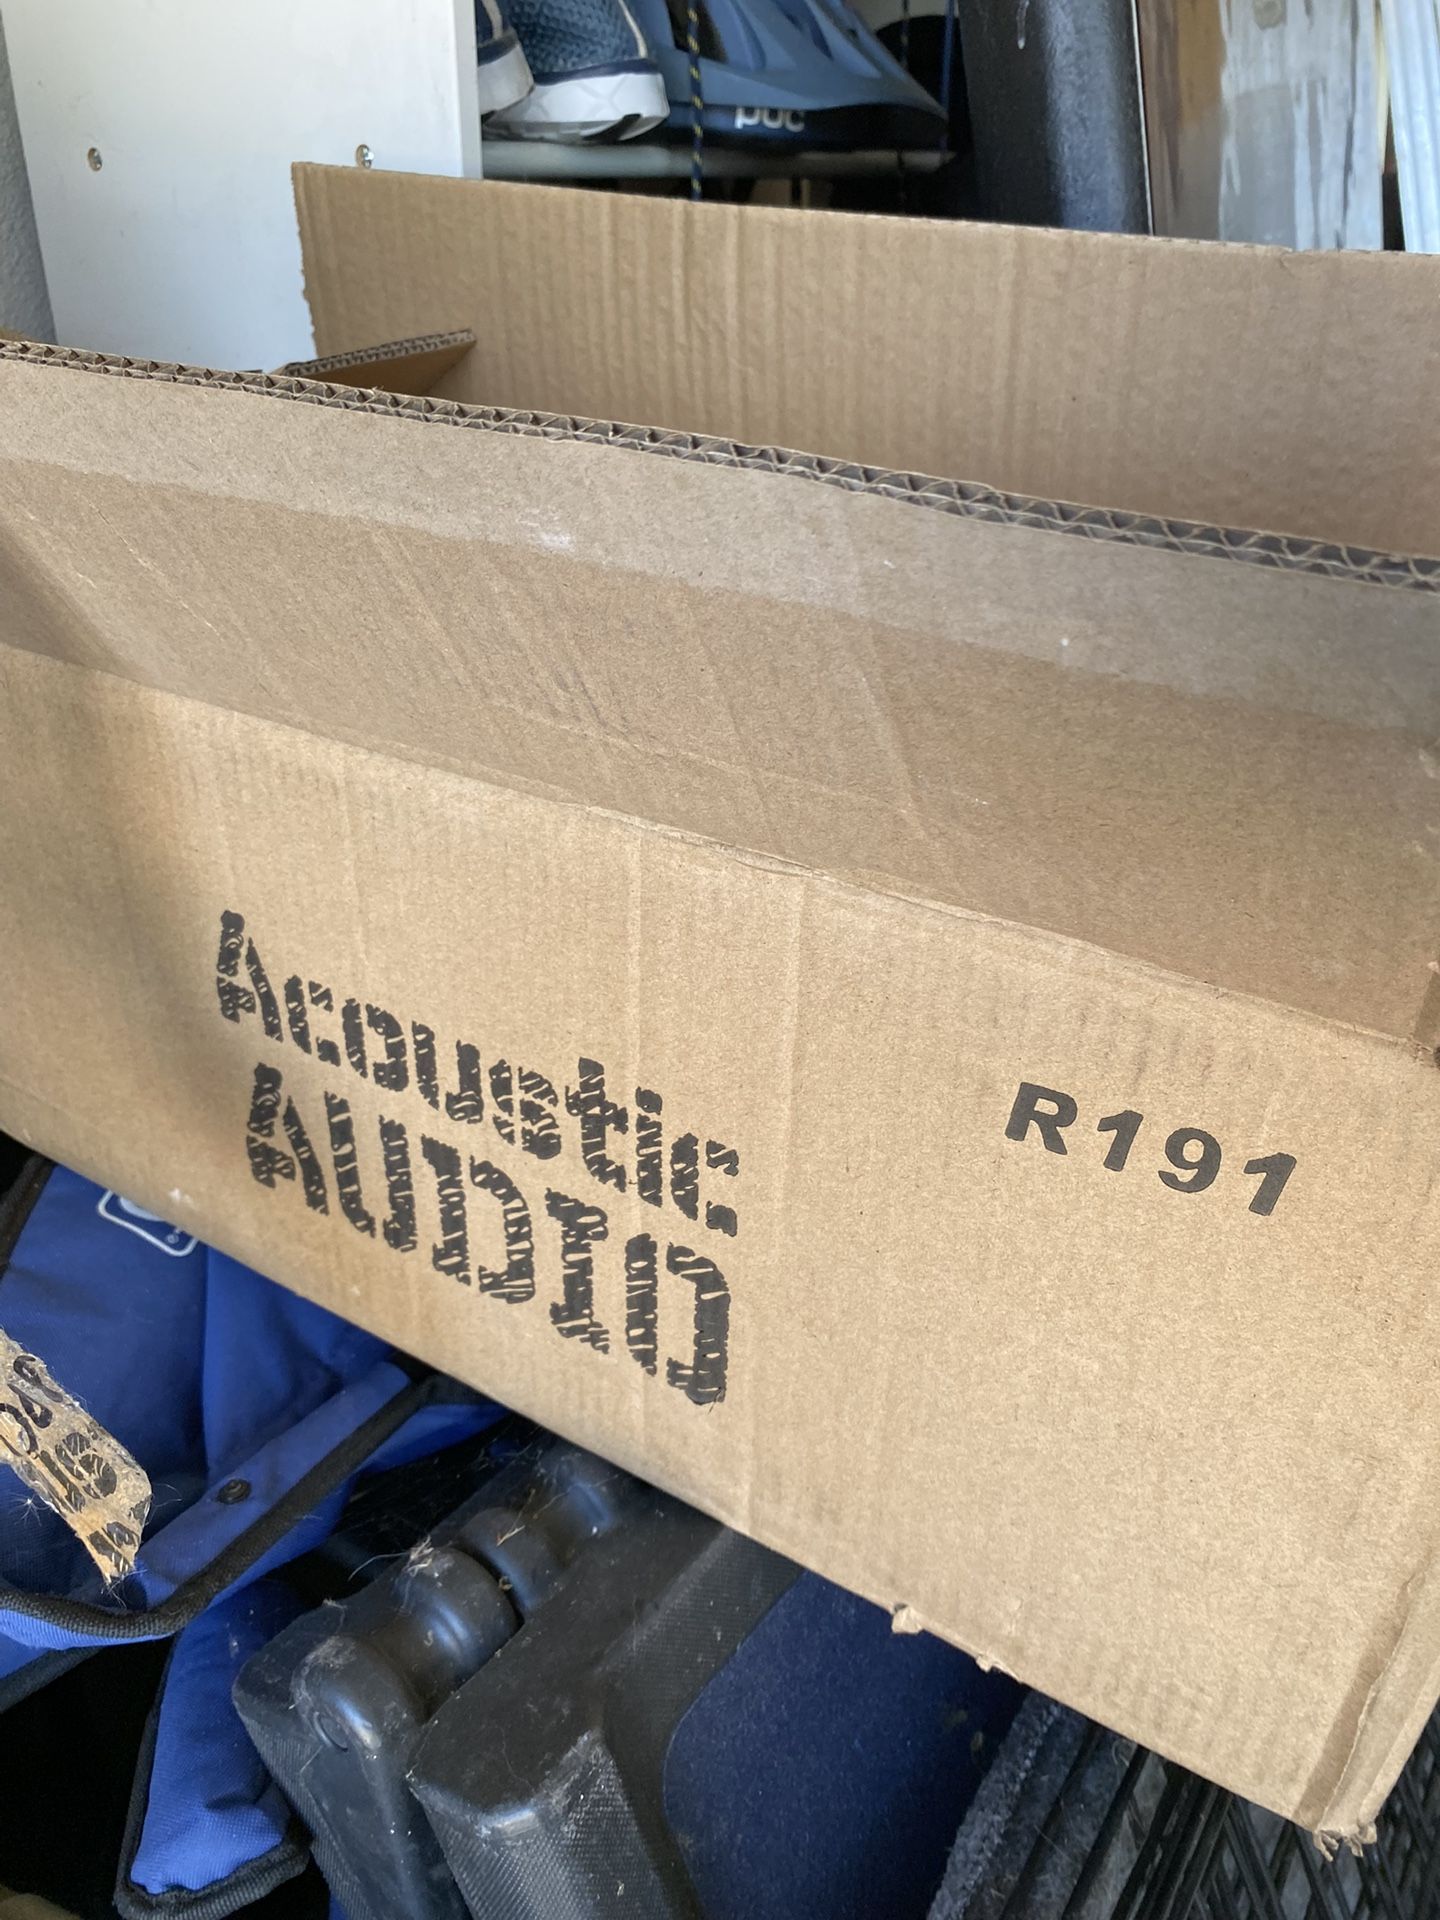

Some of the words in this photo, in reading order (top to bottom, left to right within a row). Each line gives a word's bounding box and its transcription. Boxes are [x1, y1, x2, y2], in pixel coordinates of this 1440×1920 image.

[216, 910, 739, 1237] Acoustic
[246, 1062, 731, 1406] AUDIO
[1004, 1081, 1298, 1217] R191
